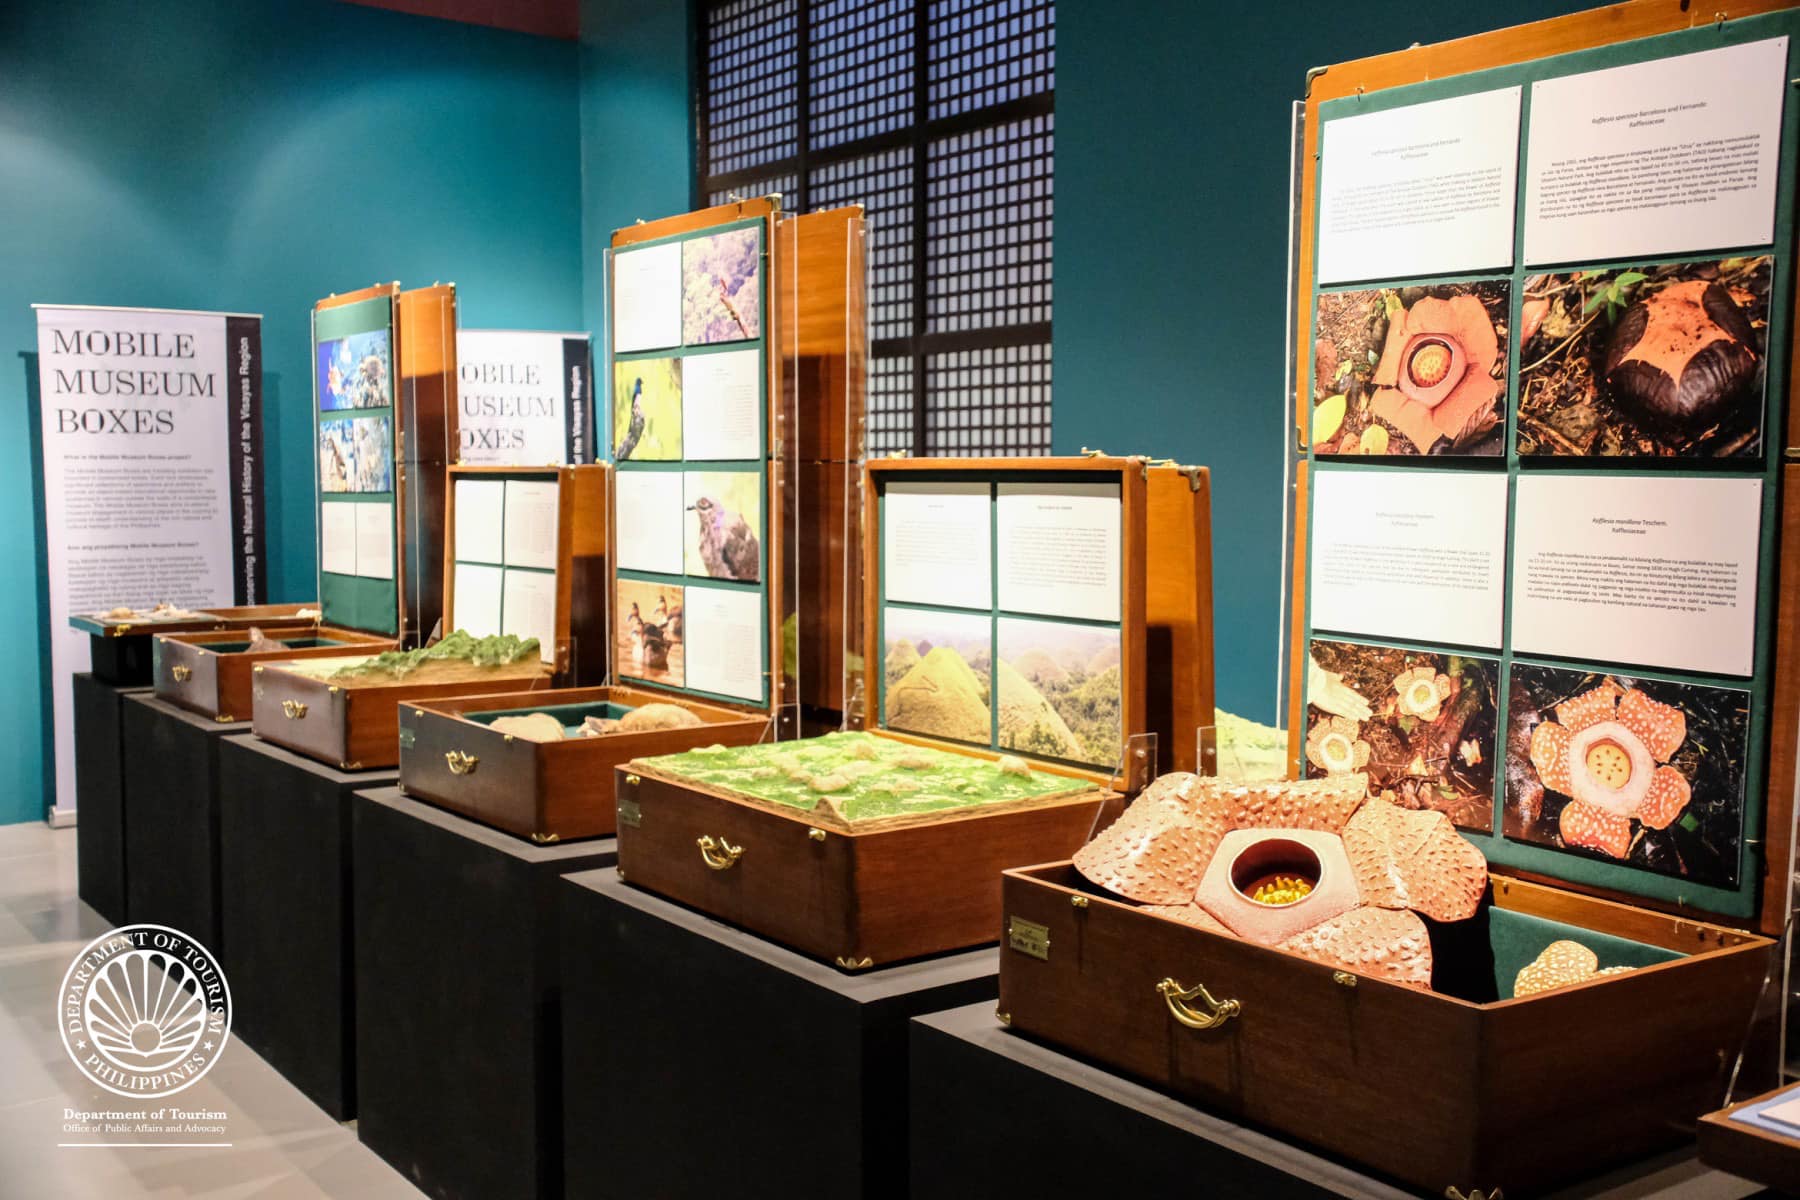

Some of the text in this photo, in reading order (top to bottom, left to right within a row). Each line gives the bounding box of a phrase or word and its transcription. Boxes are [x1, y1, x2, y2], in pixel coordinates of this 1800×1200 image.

[52, 328, 194, 358] MOBILE
[239, 337, 252, 375] Region
[55, 369, 216, 398] MUSEUM
[462, 362, 540, 384] OBILE
[240, 378, 252, 420] Visayas
[464, 395, 554, 417] USEUM
[57, 408, 174, 435] BOXES
[241, 423, 251, 439] the
[241, 442, 251, 453] of
[462, 428, 524, 449] OXES
[242, 455, 253, 494] History
[243, 496, 253, 534] Natural
[244, 537, 253, 554] the
